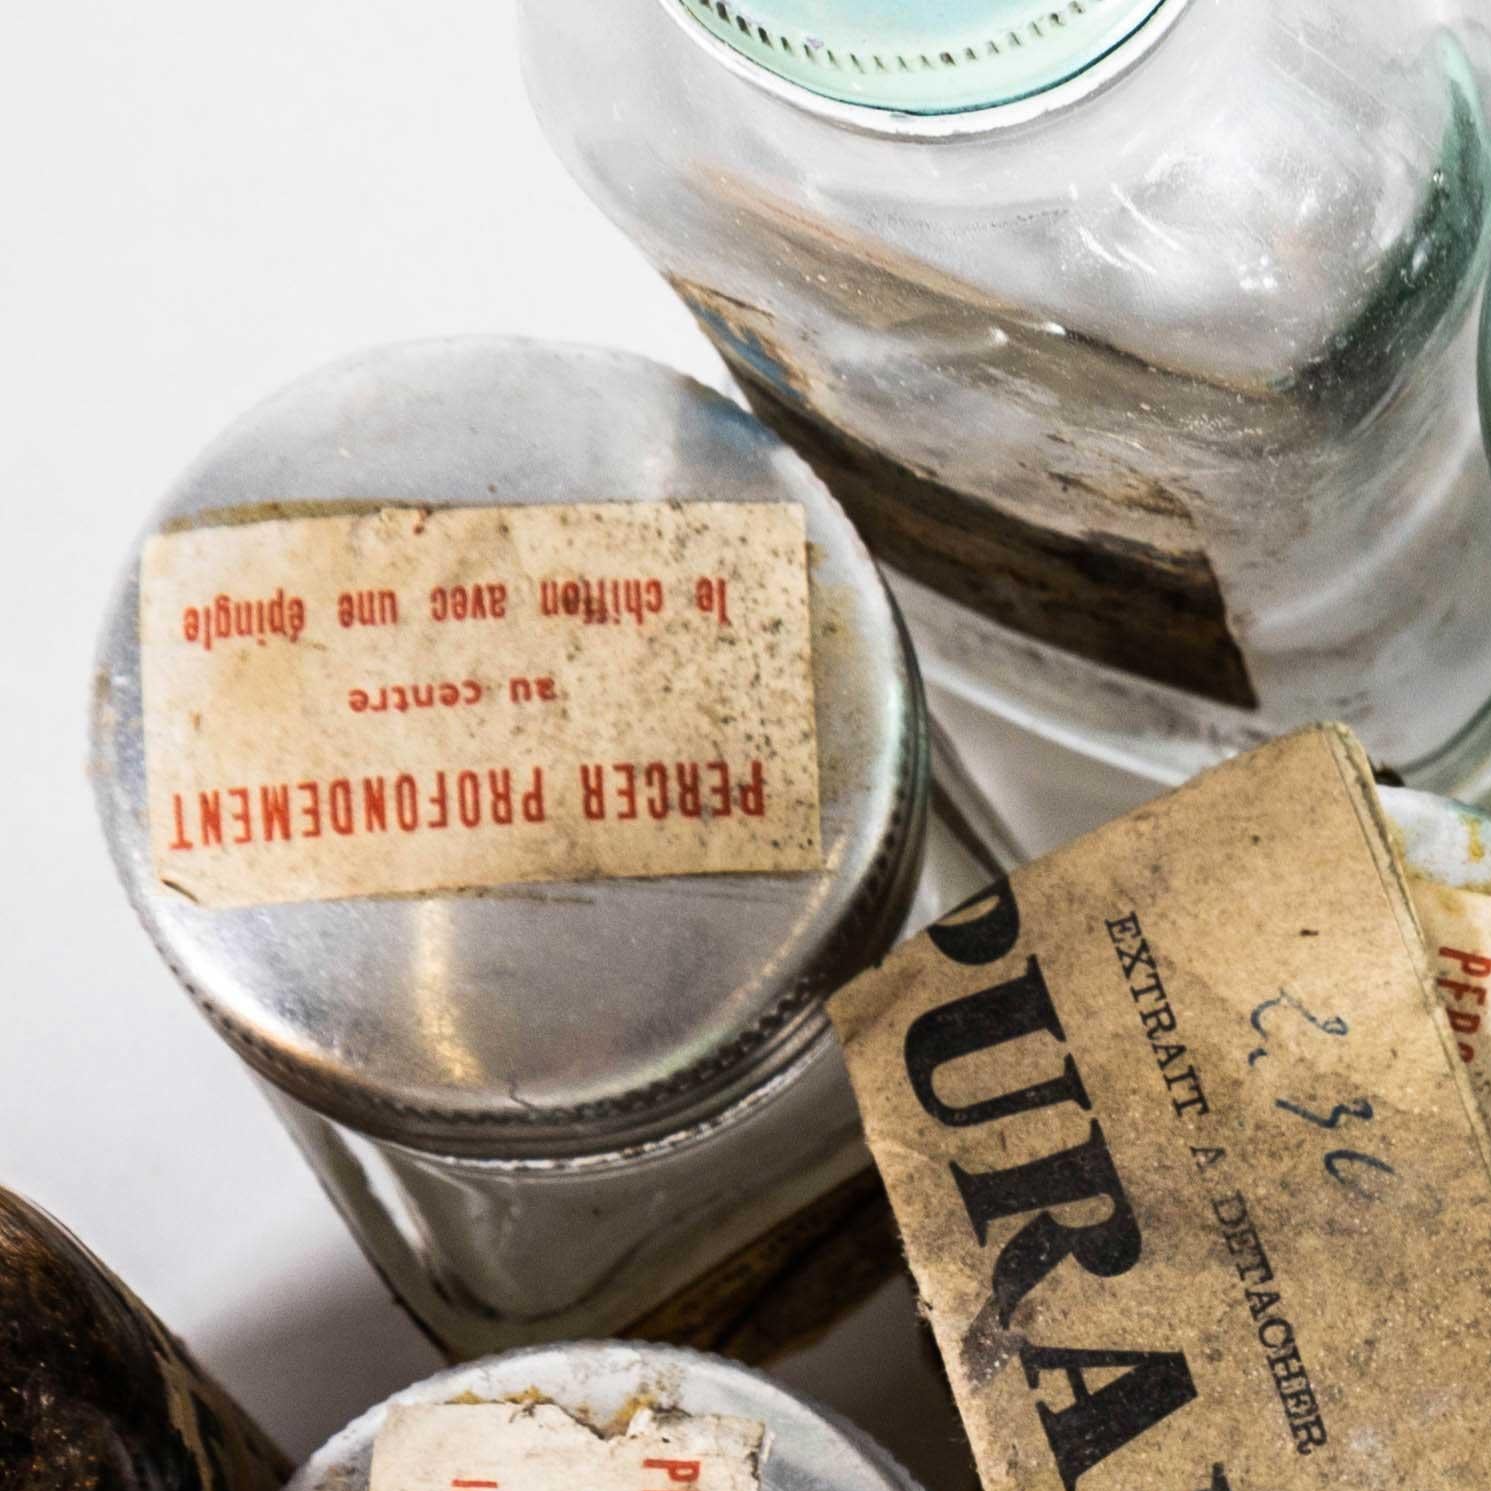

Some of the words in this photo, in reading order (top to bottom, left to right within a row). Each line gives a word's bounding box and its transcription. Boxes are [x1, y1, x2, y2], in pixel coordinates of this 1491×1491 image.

[182, 591, 306, 650] épingle
[338, 588, 398, 626] une
[431, 579, 507, 622] avec
[541, 579, 663, 626] chiffon
[694, 579, 728, 624] le
[348, 681, 483, 713] centre
[509, 676, 557, 703] au
[169, 766, 545, 851] PROFONDEMENT
[581, 760, 767, 822] PERCER
[1104, 911, 1210, 1121] EXTRAIT
[1190, 1142, 1227, 1175] A
[1209, 1188, 1329, 1455] DETACHER
